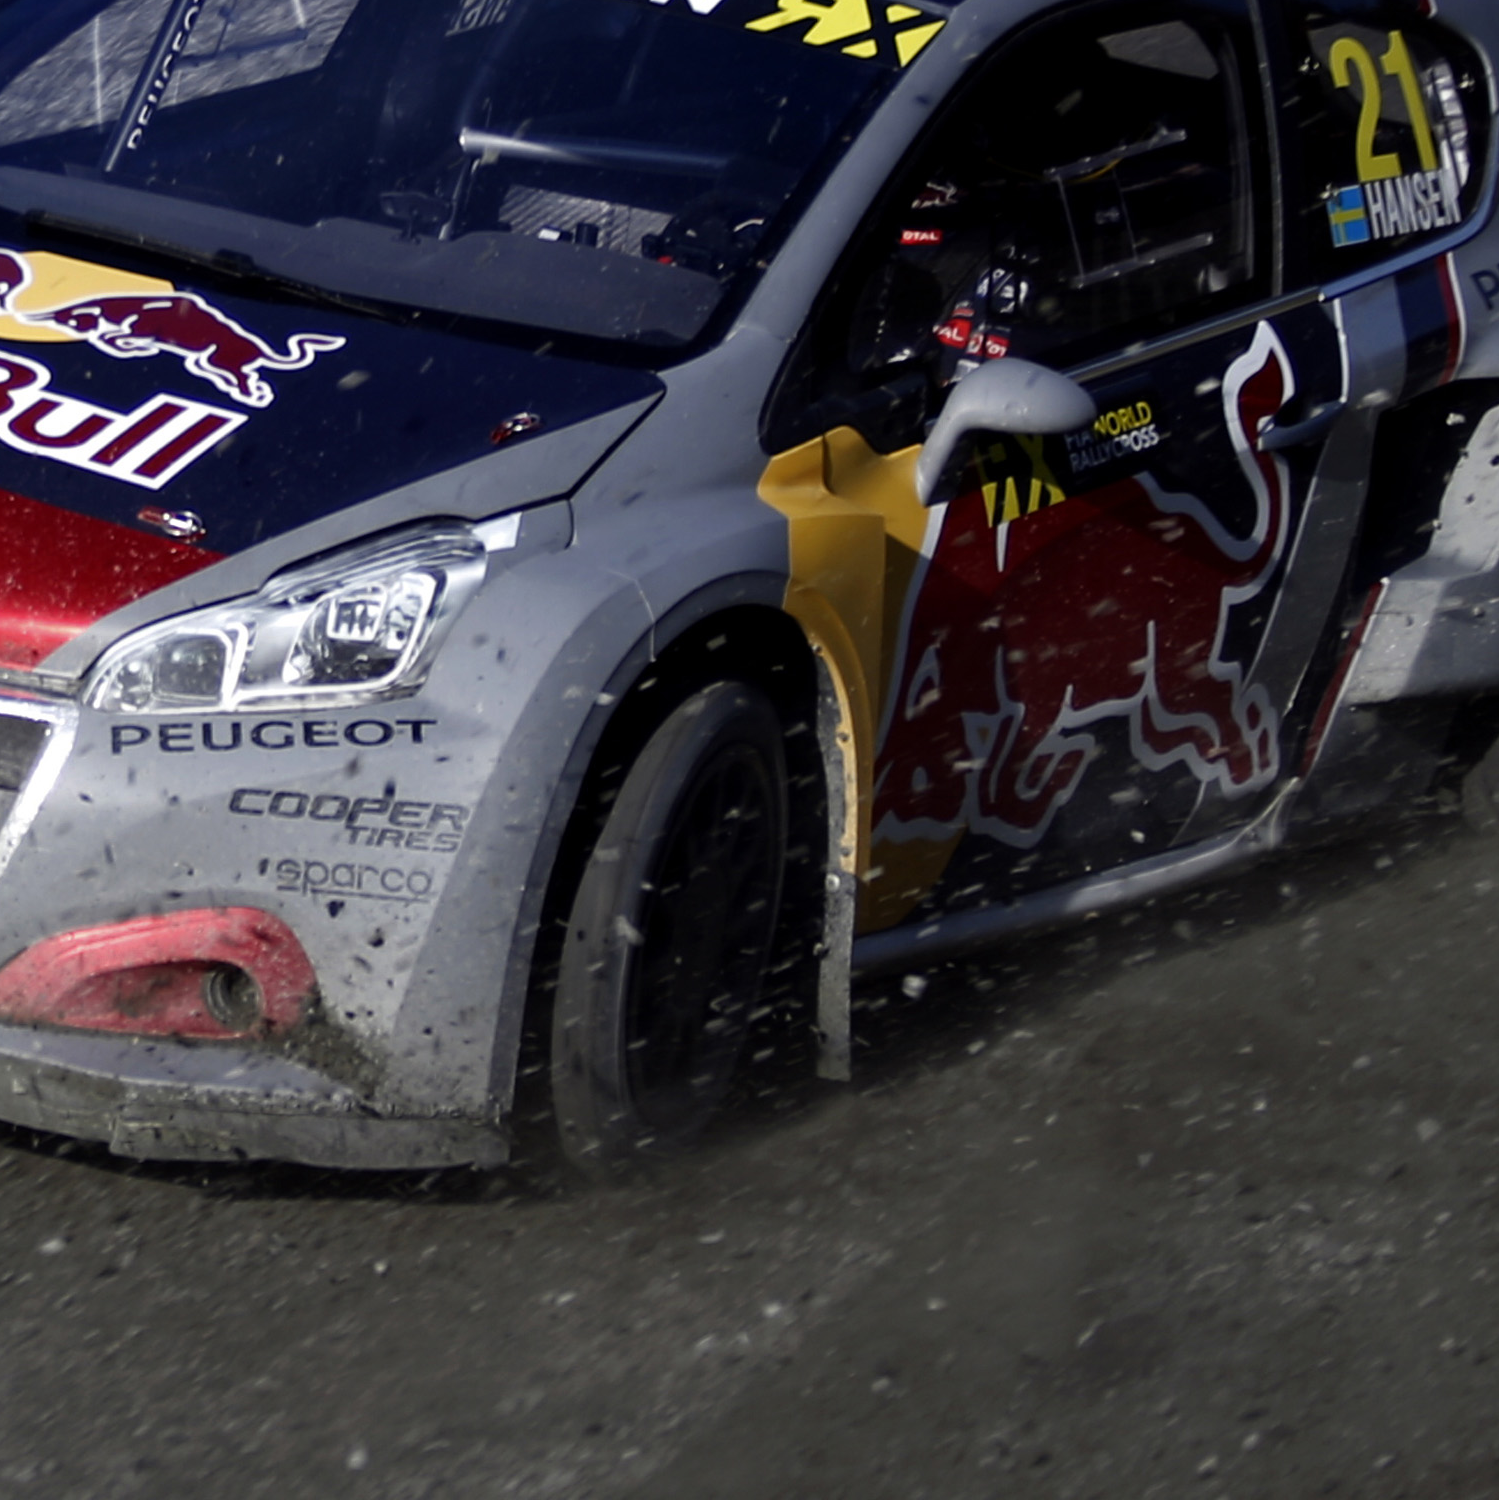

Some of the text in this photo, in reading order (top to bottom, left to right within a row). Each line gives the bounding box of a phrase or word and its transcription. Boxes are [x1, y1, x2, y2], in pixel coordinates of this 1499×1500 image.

[1327, 30, 1438, 183] 21
[1365, 166, 1461, 239] HANSEN
[1068, 422, 1160, 474] RALLYCROSS
[110, 719, 437, 755] PEUGEOT
[229, 788, 470, 832] COOPER
[347, 826, 462, 853] TIRES
[276, 857, 433, 902] sparco
